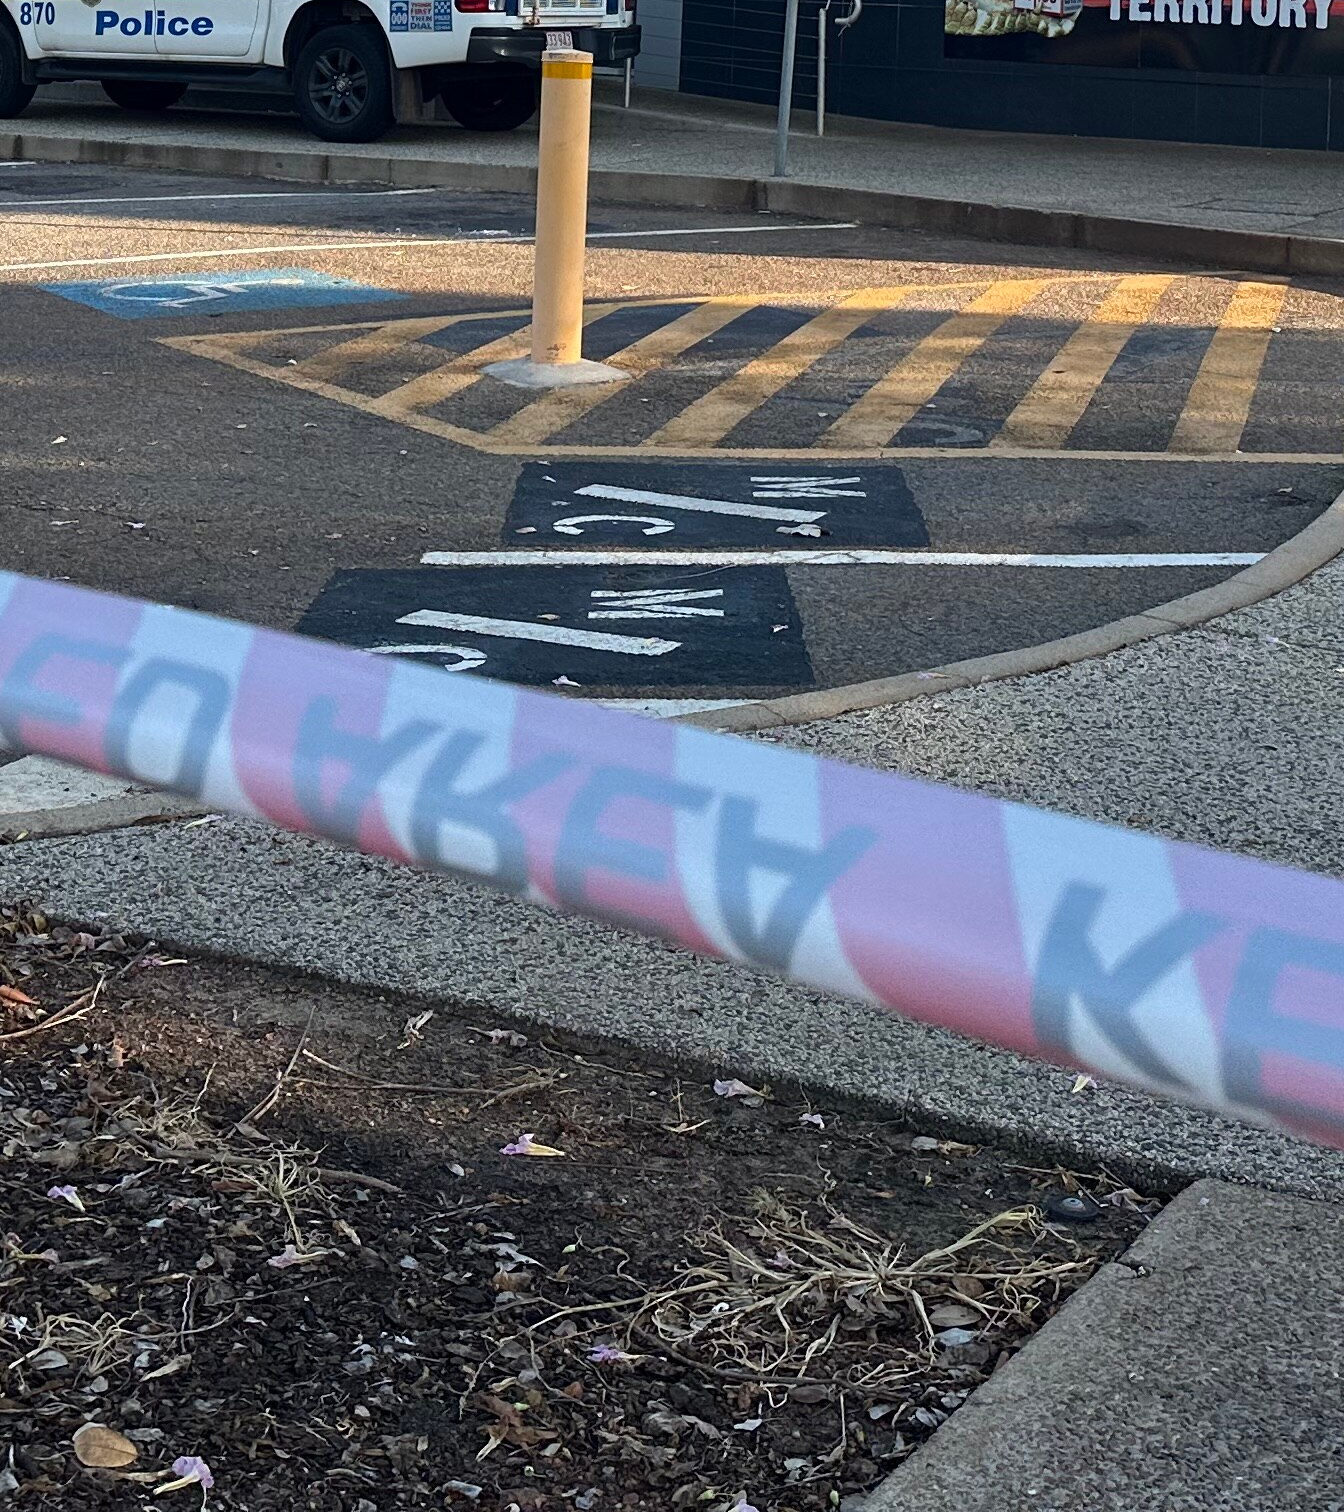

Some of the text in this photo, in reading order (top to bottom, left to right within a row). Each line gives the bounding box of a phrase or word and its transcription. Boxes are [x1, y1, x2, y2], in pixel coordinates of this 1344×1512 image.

[20, 1, 55, 26] 870
[95, 10, 214, 36] Police
[391, 12, 407, 25] 000
